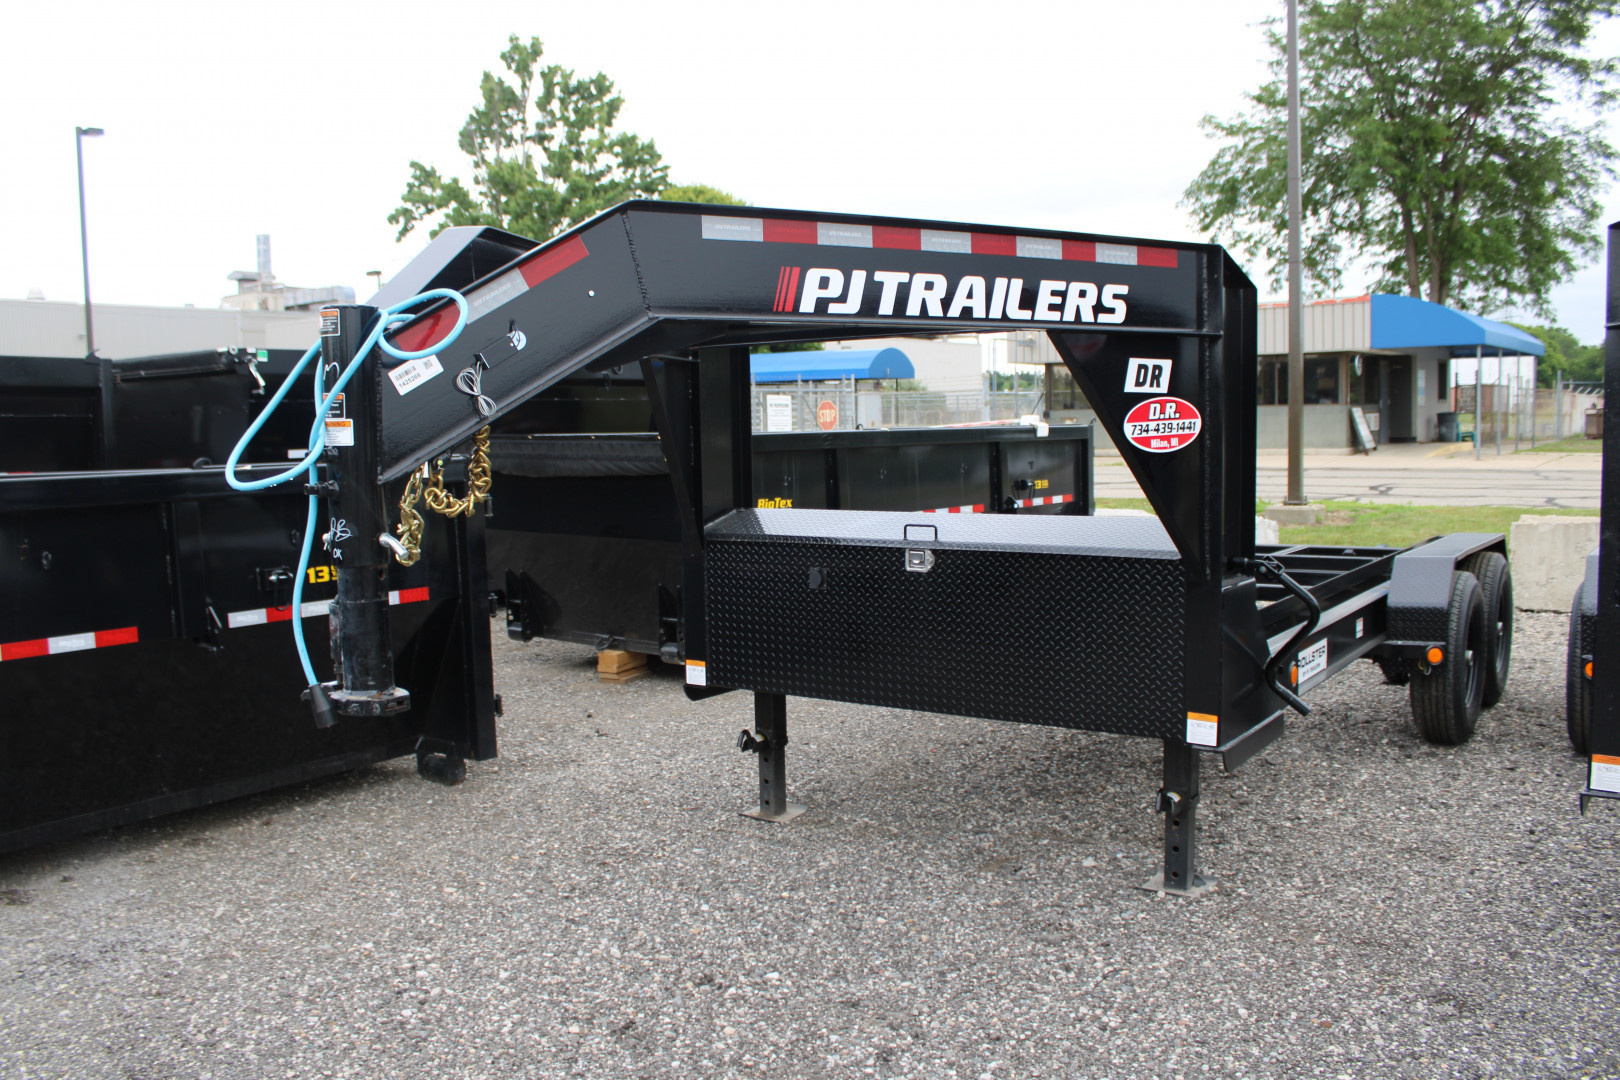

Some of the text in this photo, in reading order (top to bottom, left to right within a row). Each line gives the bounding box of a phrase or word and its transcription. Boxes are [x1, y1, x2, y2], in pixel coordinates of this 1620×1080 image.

[799, 268, 1130, 324] PJ TRAILERS
[1134, 363, 1163, 388] DR
[819, 409, 836, 423] STOP
[1148, 402, 1180, 420] D.R.
[1131, 421, 1197, 436] 734-439-1441
[1150, 437, 1179, 449] Milan, MI
